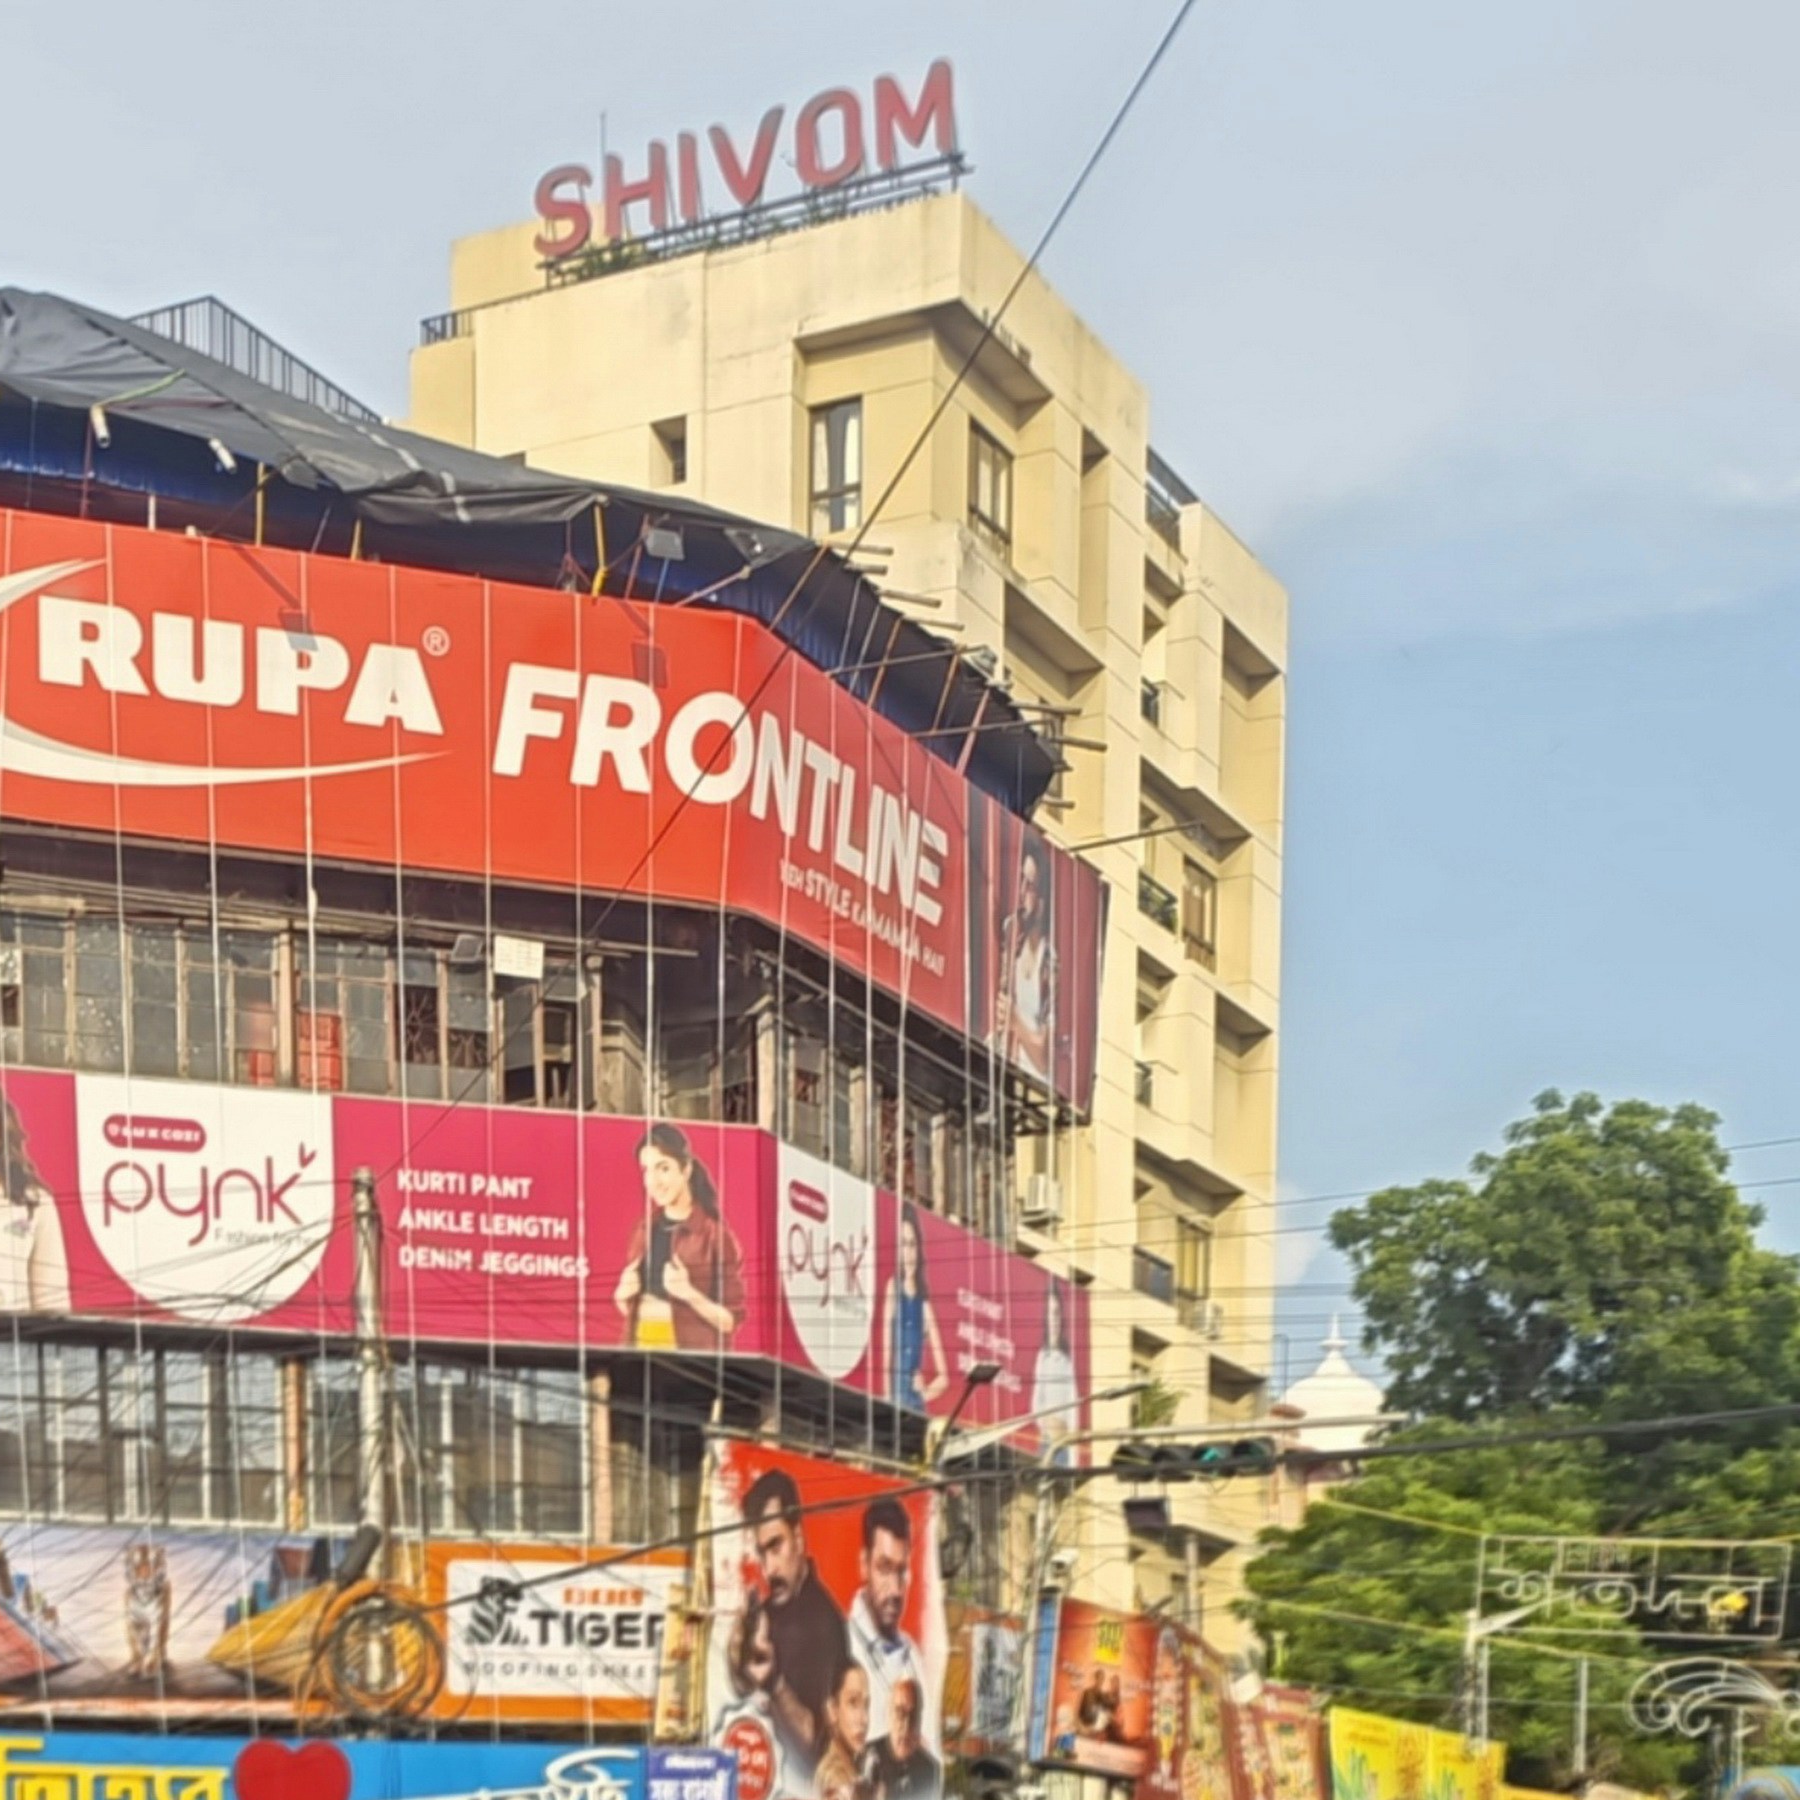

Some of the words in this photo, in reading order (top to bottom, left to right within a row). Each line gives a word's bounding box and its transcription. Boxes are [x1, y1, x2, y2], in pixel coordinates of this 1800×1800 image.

[532, 57, 953, 258] SHIVOM
[38, 595, 444, 736] RUPA
[492, 662, 949, 924] FRONTLINE
[805, 868, 851, 918] STYLE
[103, 1155, 303, 1246] pynk
[398, 1169, 467, 1197] KURTI
[471, 1173, 532, 1199] PANT
[398, 1208, 475, 1236] ANKLE
[480, 1212, 568, 1240] LENGTH
[399, 1245, 473, 1272] DENIM
[478, 1247, 590, 1278] JEGGINGS
